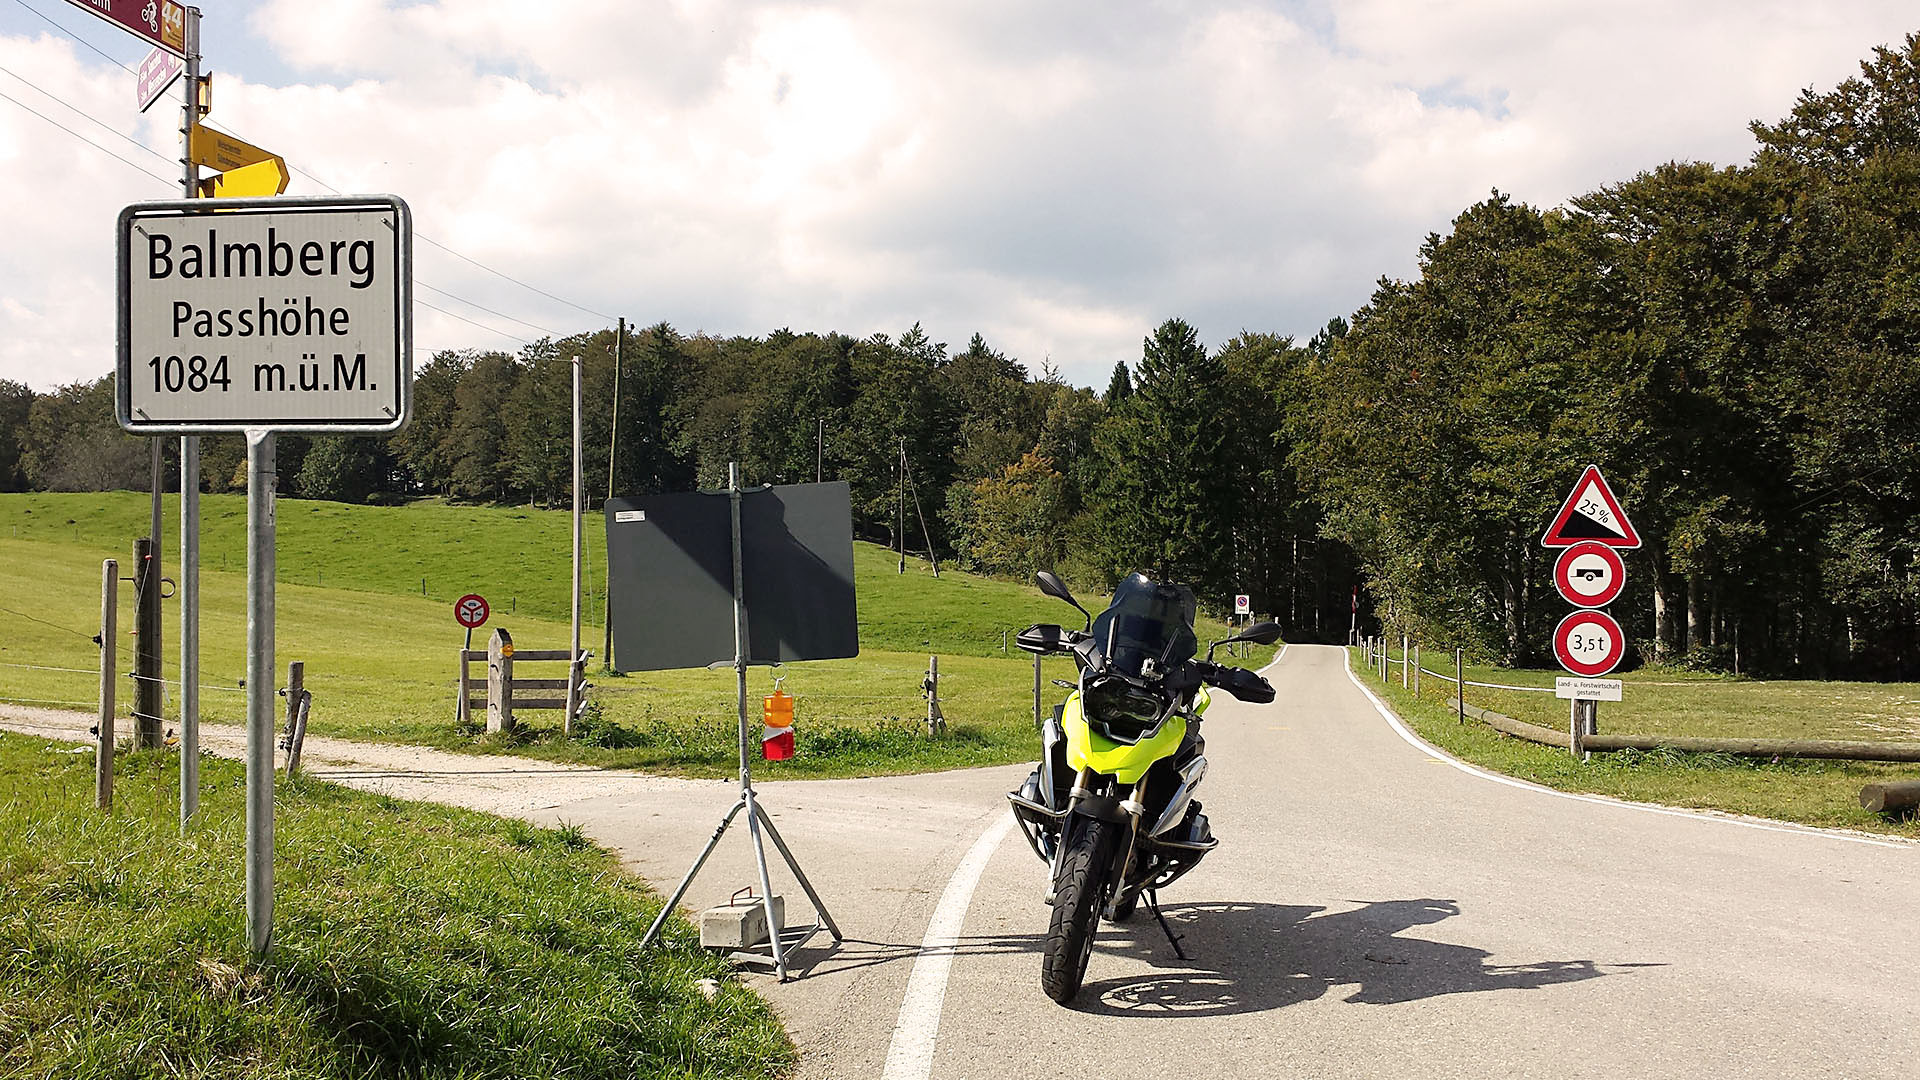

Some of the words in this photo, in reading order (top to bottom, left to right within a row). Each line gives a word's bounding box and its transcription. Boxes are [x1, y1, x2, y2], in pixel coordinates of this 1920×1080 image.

[161, 2, 182, 29] 44
[148, 228, 375, 289] Balmberg
[172, 296, 350, 338] Passhöhe
[148, 355, 232, 393] 1084
[253, 353, 378, 392] m.ü.M.
[1580, 681, 1620, 690] Forstwirtschaft
